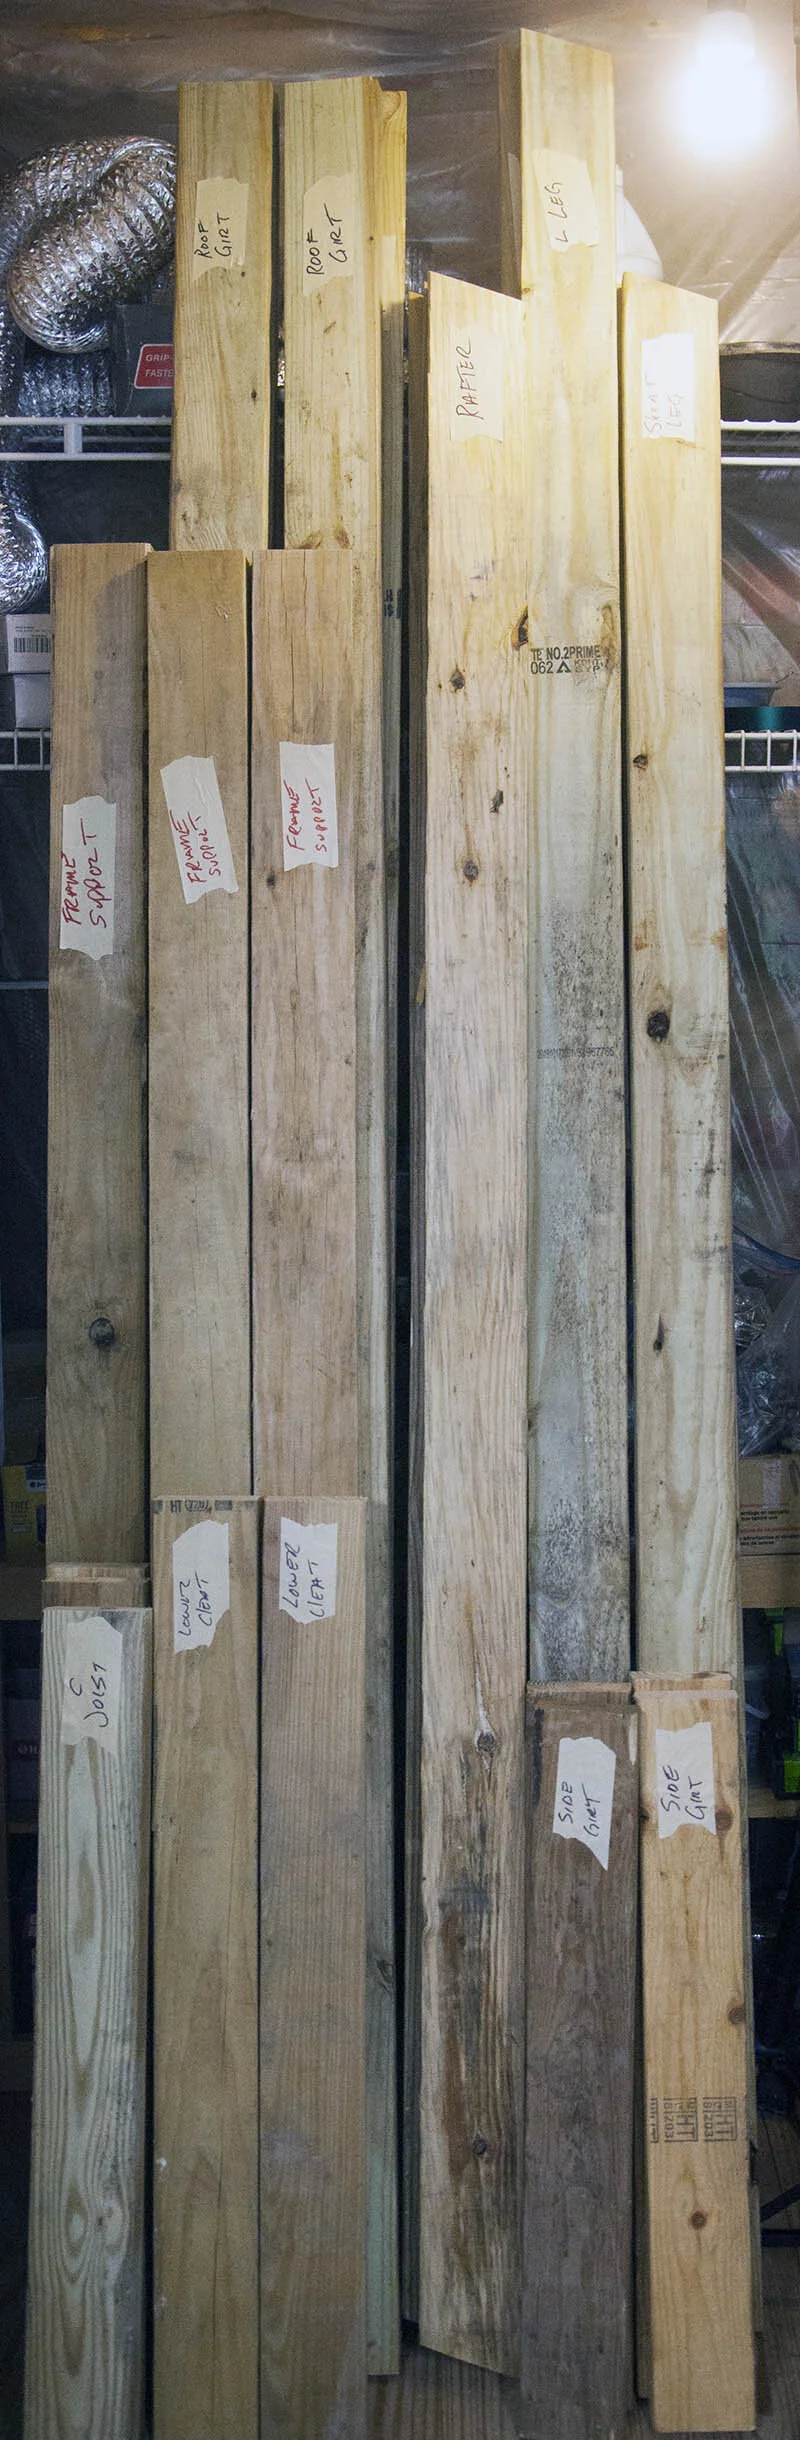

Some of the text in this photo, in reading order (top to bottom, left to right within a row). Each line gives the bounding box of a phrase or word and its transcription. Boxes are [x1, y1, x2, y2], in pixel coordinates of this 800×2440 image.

[544, 181, 569, 219] LEG
[194, 220, 213, 259] ROOF
[214, 211, 232, 257] GIRT
[306, 228, 325, 275] ROOF
[323, 203, 348, 263] GIRT
[455, 336, 484, 420] RAFTER
[530, 661, 553, 674] 062
[283, 779, 305, 851] FRAME
[169, 809, 207, 883] FRAME
[61, 850, 82, 925] FRAME
[282, 1541, 301, 1608] LOWER
[69, 1677, 82, 1696] C
[83, 1662, 109, 1727] JOIST
[558, 1781, 573, 1824] SIDE
[581, 1783, 600, 1837] GIRT
[660, 1765, 680, 1811] SIDE
[684, 1776, 707, 1820] GIRT
[676, 2114, 695, 2139] HT
